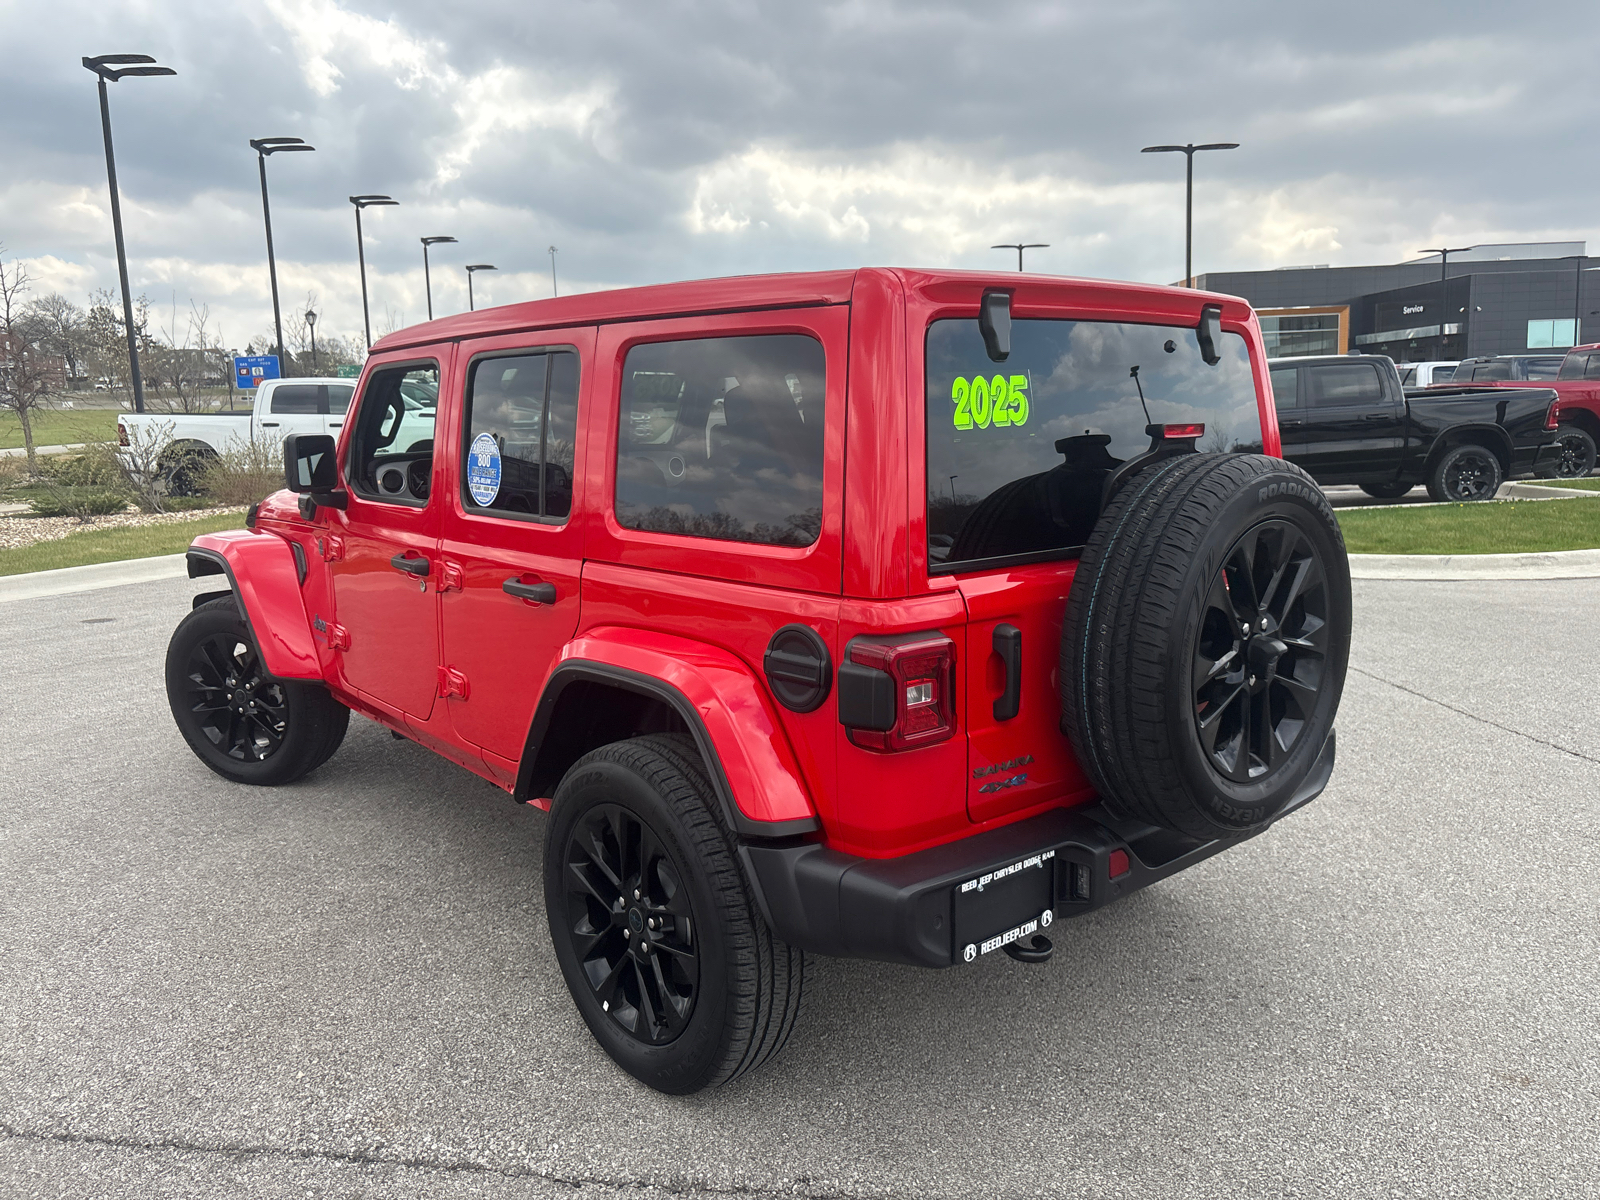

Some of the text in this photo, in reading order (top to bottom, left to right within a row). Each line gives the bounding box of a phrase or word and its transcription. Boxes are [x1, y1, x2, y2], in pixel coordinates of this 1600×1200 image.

[1402, 304, 1424, 315] Service
[951, 374, 1029, 431] 2025
[477, 454, 491, 467] 800
[1258, 482, 1319, 506] ROADIAN
[973, 754, 1035, 779] SAHARA
[1210, 794, 1265, 822] NEXEN
[961, 850, 1055, 893] REED JEEP CHRYSLER DODGE RAM
[981, 919, 1038, 955] REEDJEEP.COM
